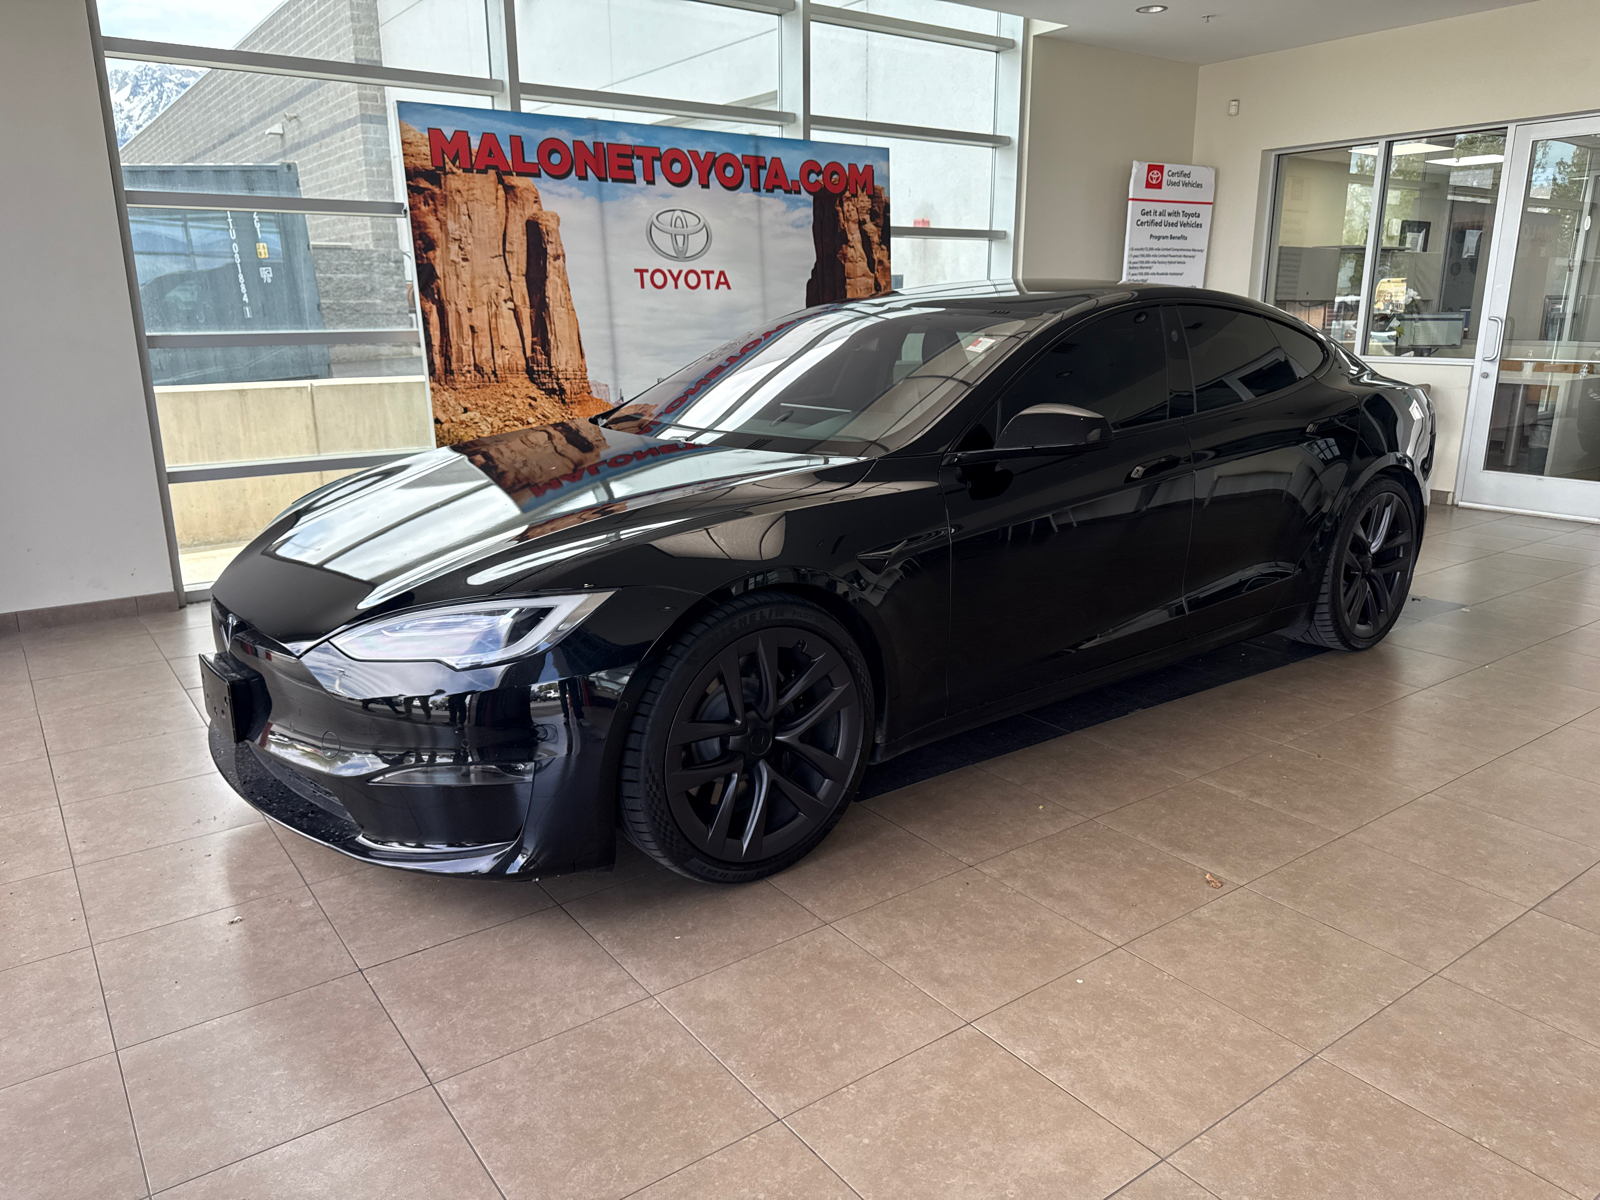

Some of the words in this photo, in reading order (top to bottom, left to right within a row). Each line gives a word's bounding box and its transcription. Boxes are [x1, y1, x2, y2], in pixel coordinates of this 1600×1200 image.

[427, 127, 876, 196] MALONETOYOTA.COM
[1167, 170, 1191, 178] Certified
[1166, 179, 1180, 187] Used
[1181, 180, 1203, 189] Vehicles
[1140, 208, 1152, 217] Get
[1152, 209, 1158, 217] it
[1158, 209, 1167, 217] all
[1167, 210, 1181, 218] with
[1181, 210, 1201, 220] Toyota
[1136, 219, 1163, 227] Certified
[1163, 220, 1178, 228] Used
[1179, 220, 1203, 229] Vehicles
[633, 268, 732, 291] TOYOTA
